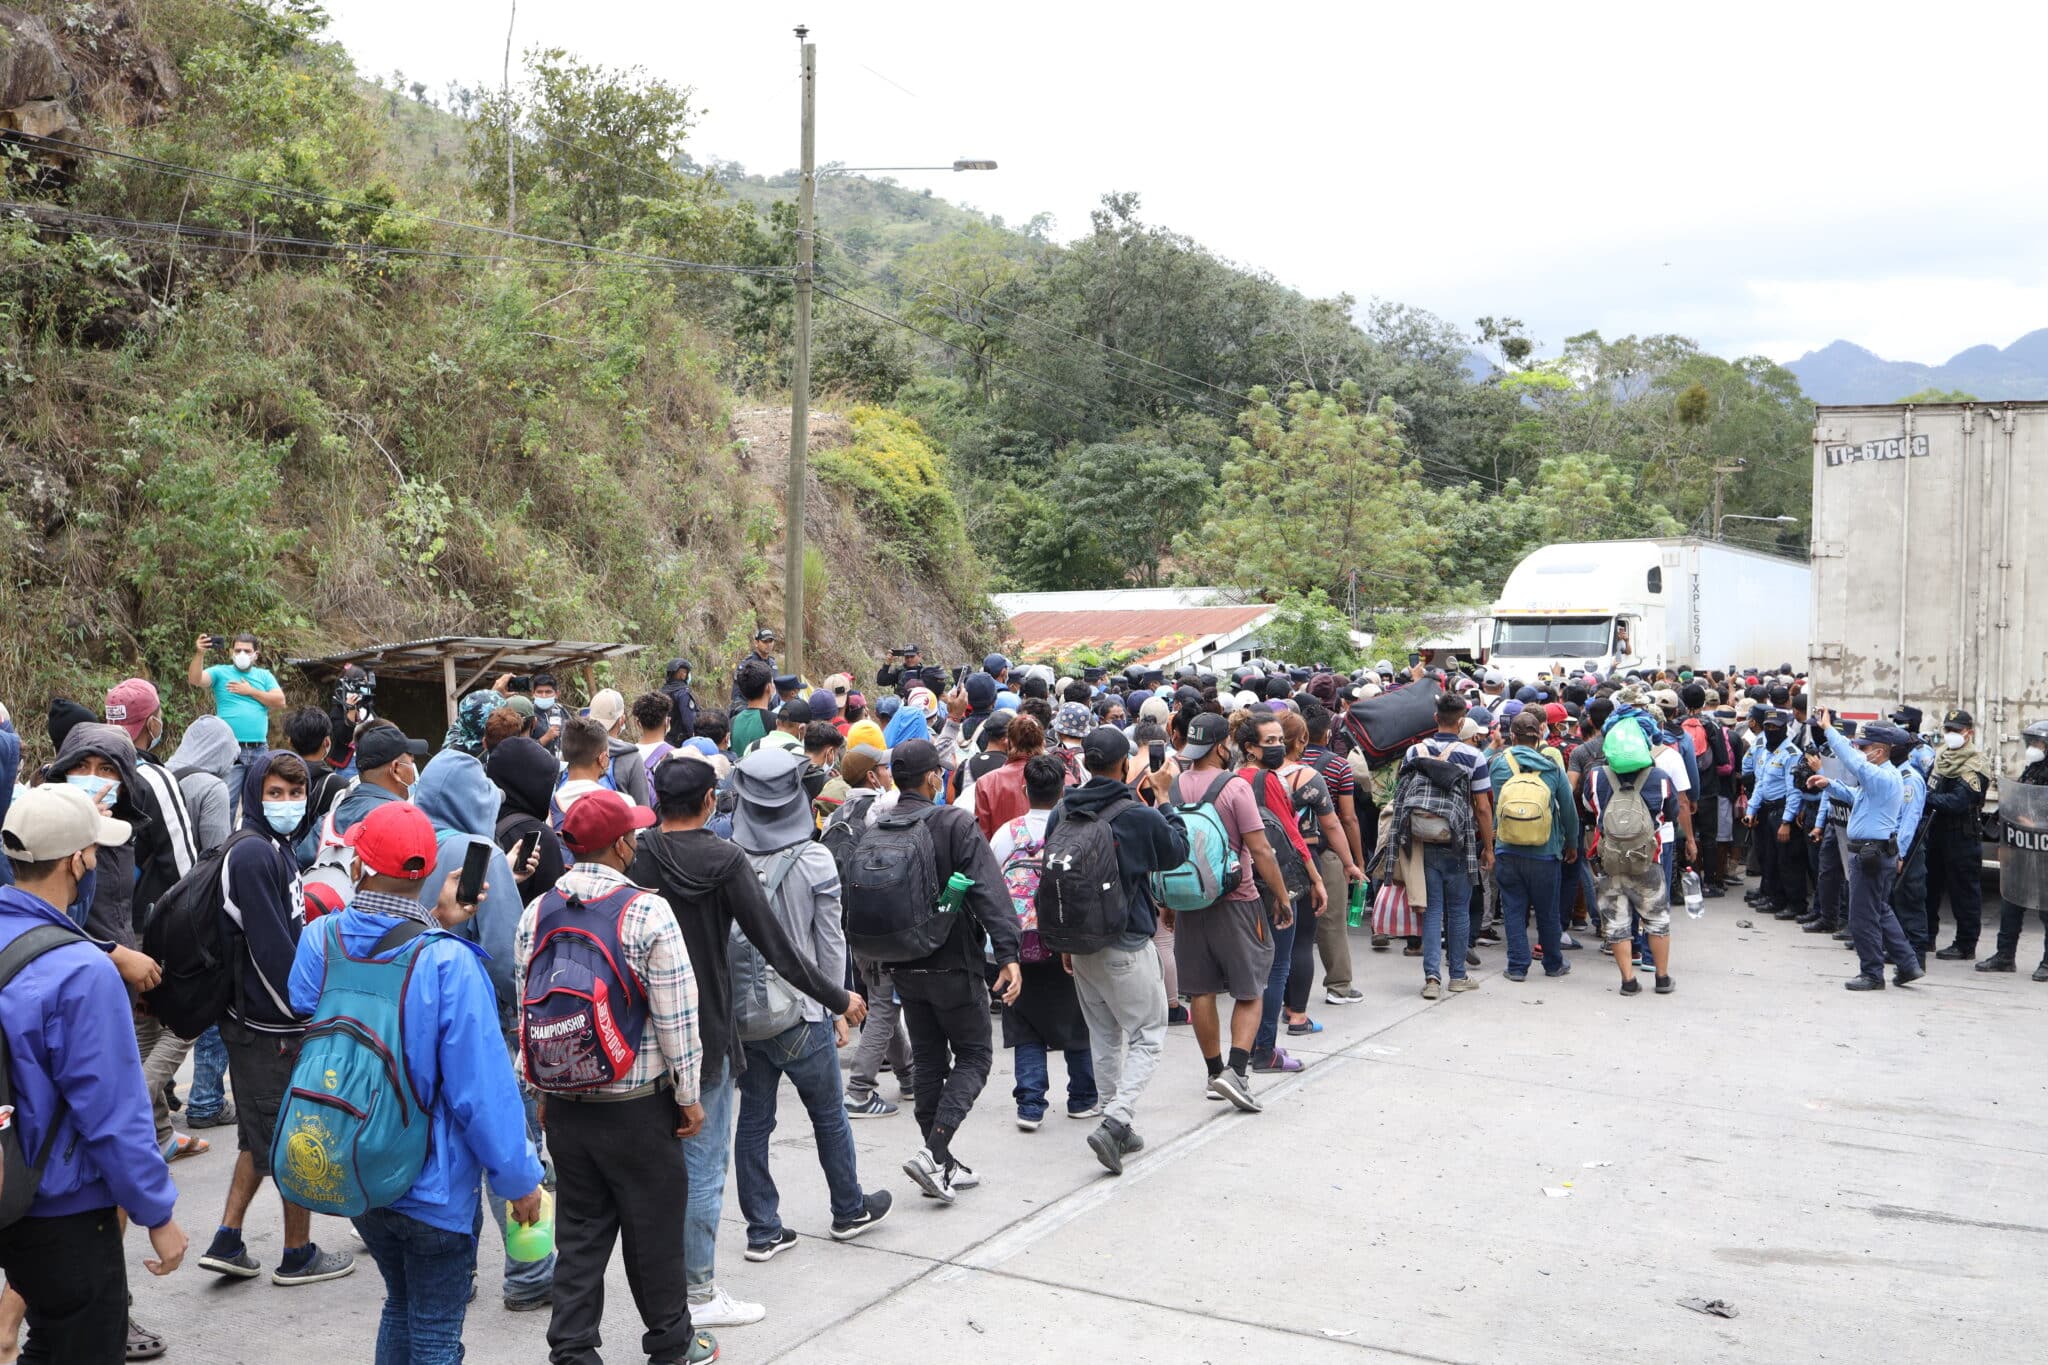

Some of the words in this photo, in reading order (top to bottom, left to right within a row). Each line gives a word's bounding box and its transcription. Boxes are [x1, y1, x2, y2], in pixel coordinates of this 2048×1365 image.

[1692, 574, 1701, 654] TXPL5670
[530, 1014, 586, 1040] CHAMPIONSHIP
[570, 1058, 602, 1080] AIR
